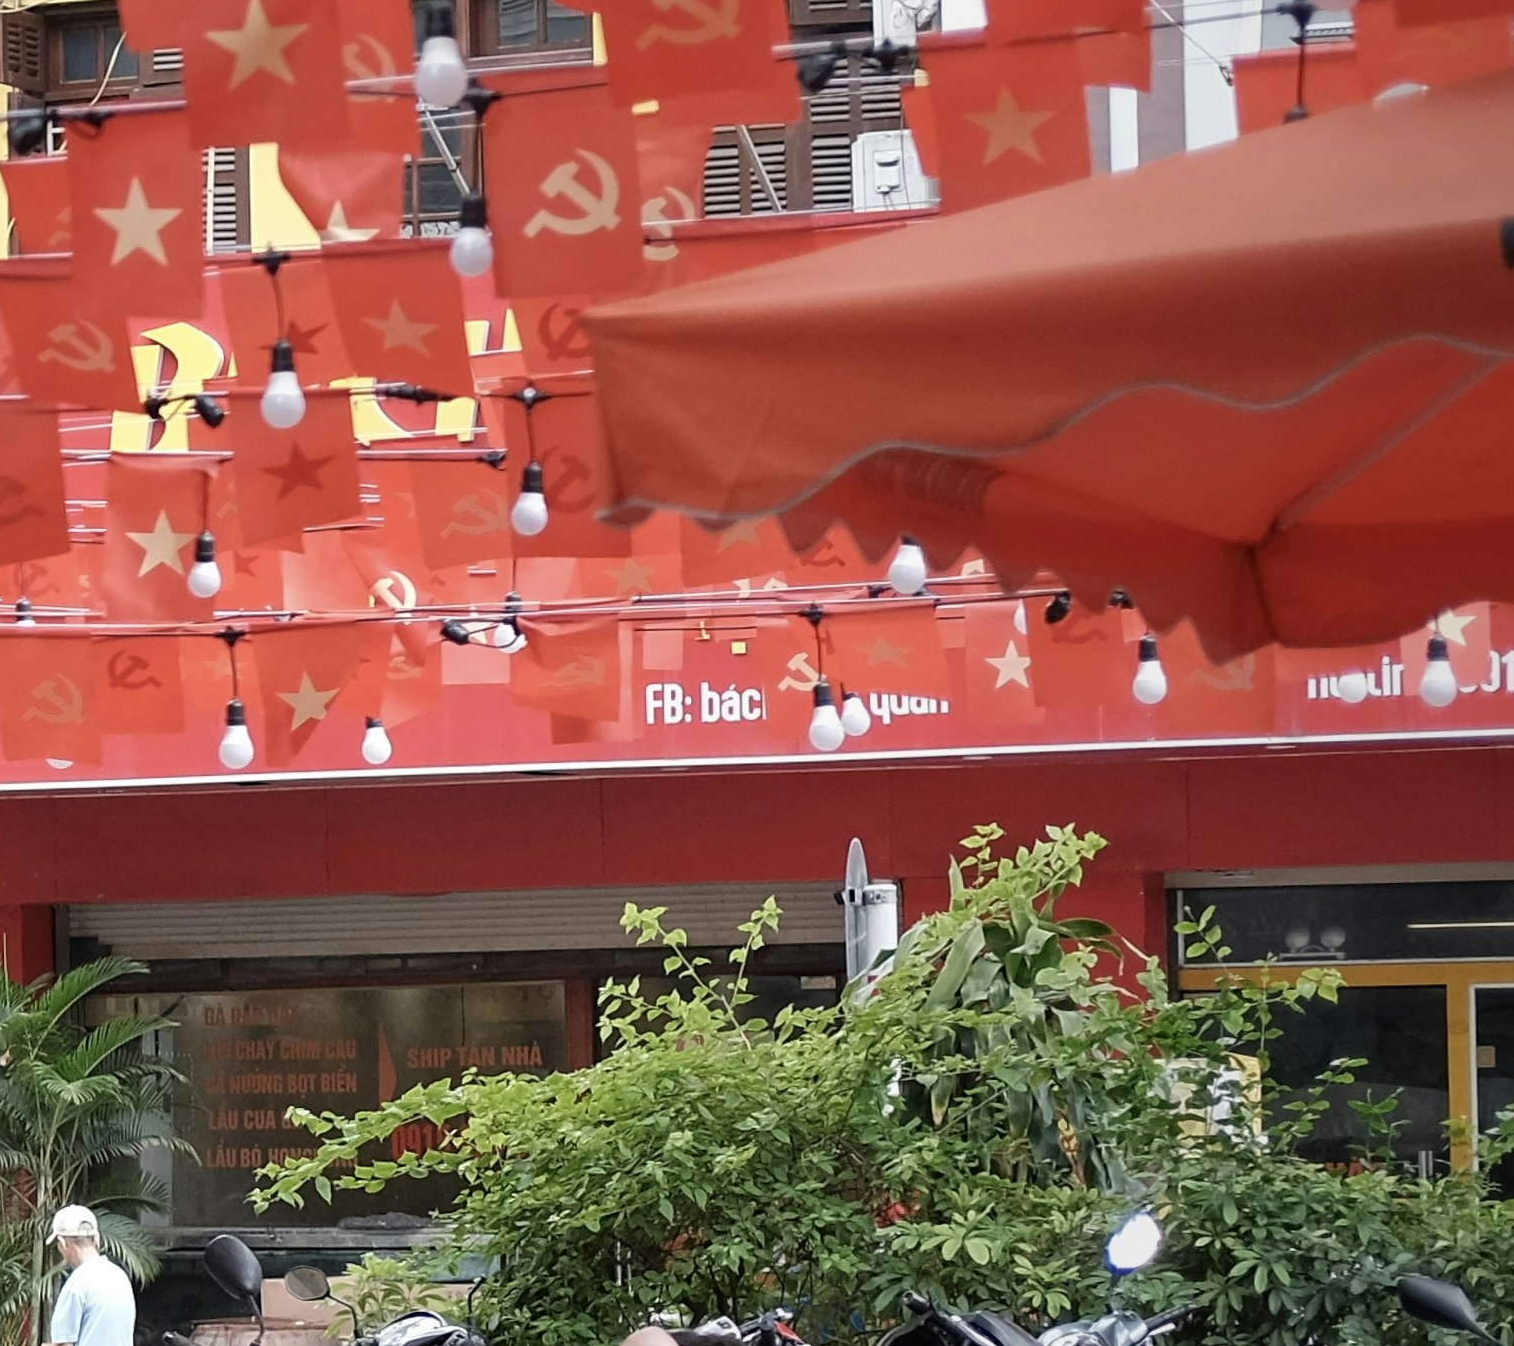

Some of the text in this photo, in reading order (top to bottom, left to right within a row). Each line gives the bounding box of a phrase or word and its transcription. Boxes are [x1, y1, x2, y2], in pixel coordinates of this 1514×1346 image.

[645, 683, 692, 725] FB:
[700, 681, 767, 723] bác
[408, 1046, 452, 1069] SHIP
[244, 1109, 276, 1130] CUA
